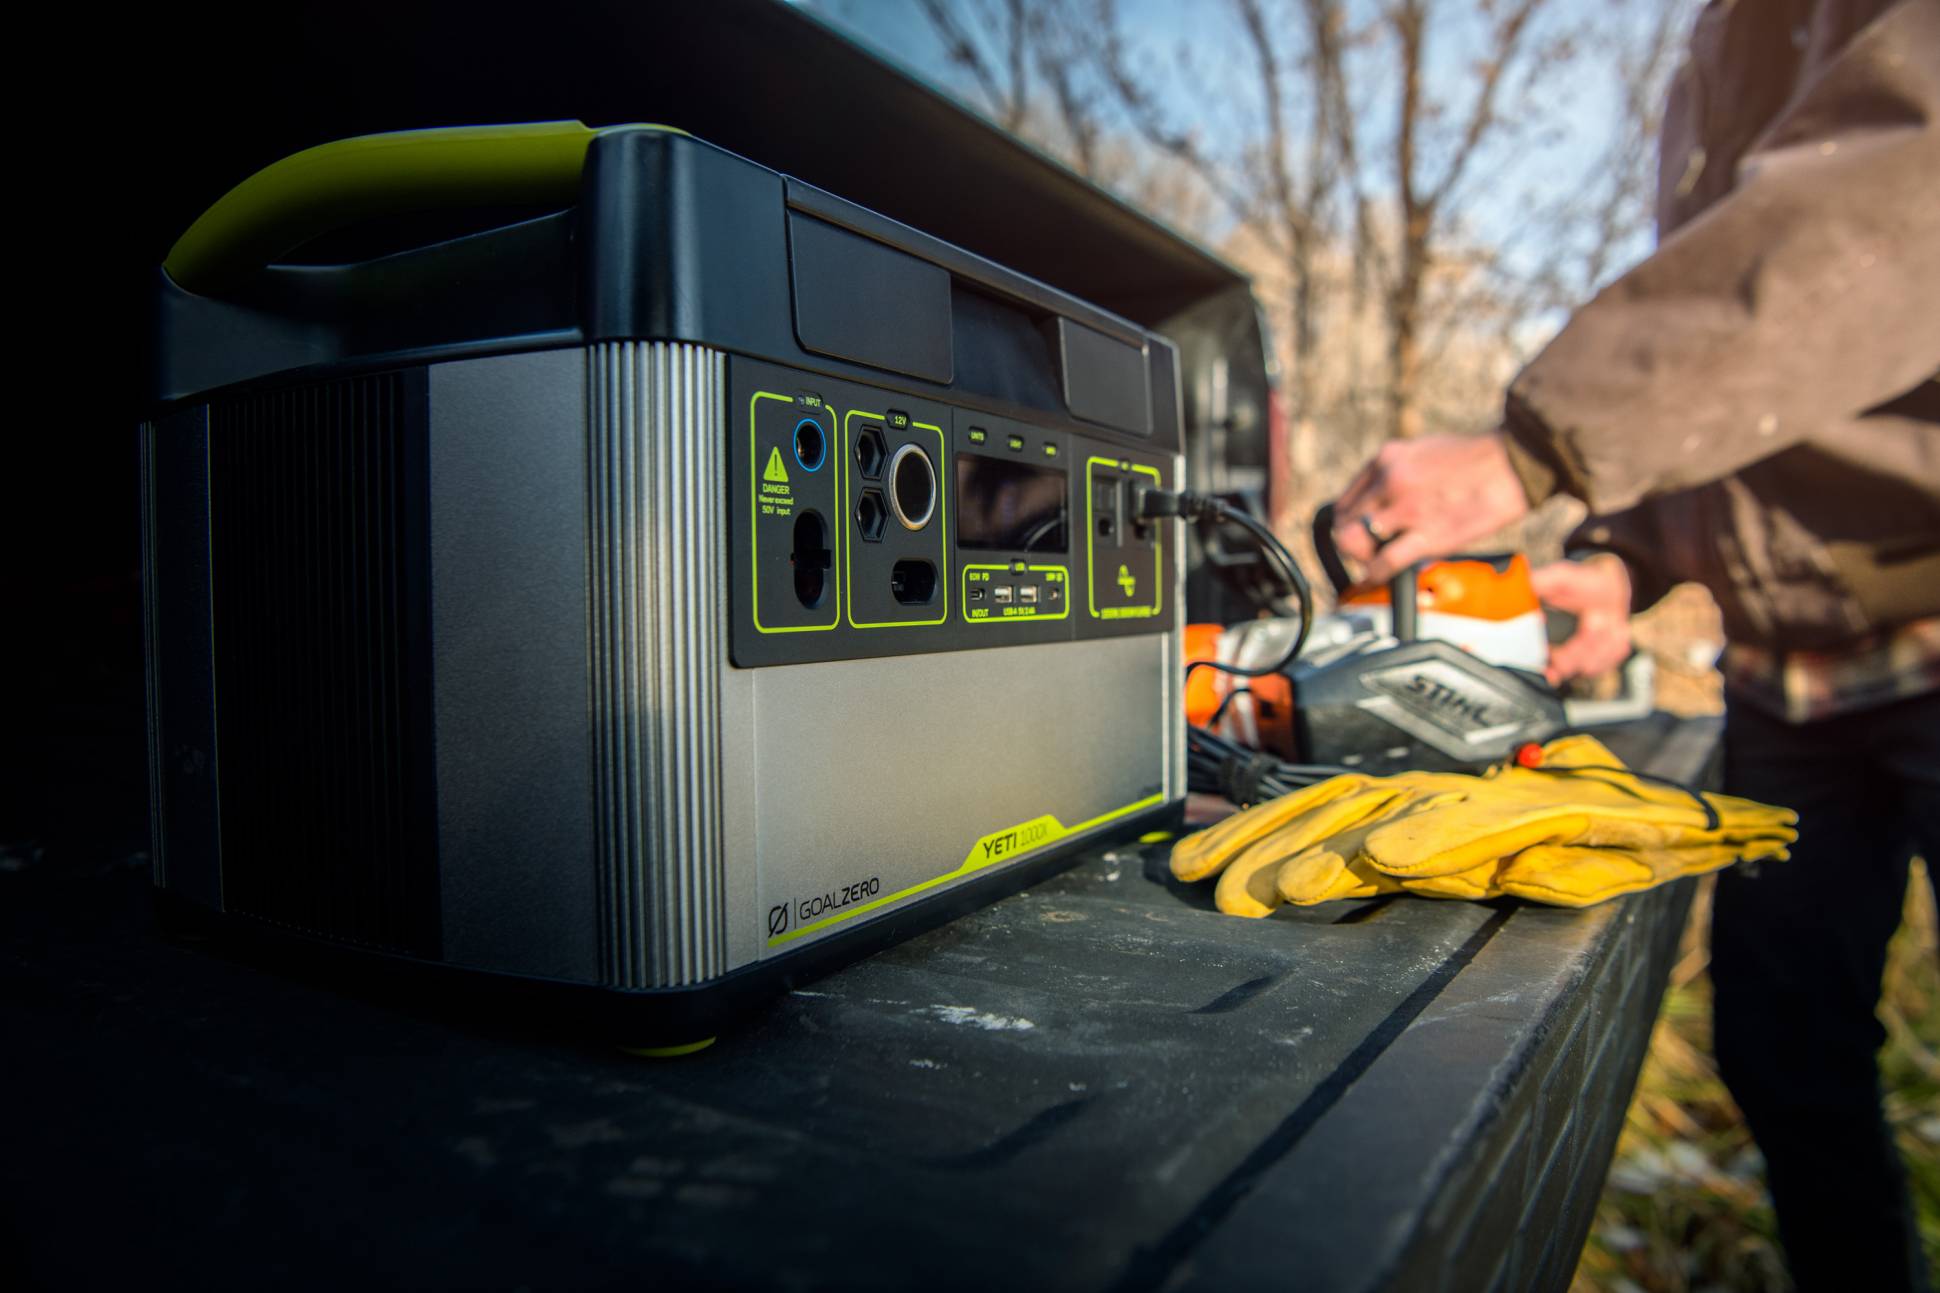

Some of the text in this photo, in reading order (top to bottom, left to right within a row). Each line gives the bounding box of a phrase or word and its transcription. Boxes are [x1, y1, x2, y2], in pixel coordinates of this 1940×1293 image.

[894, 415, 907, 425] 12V
[763, 483, 790, 495] DANGER
[983, 823, 1051, 859] YETI 1000X
